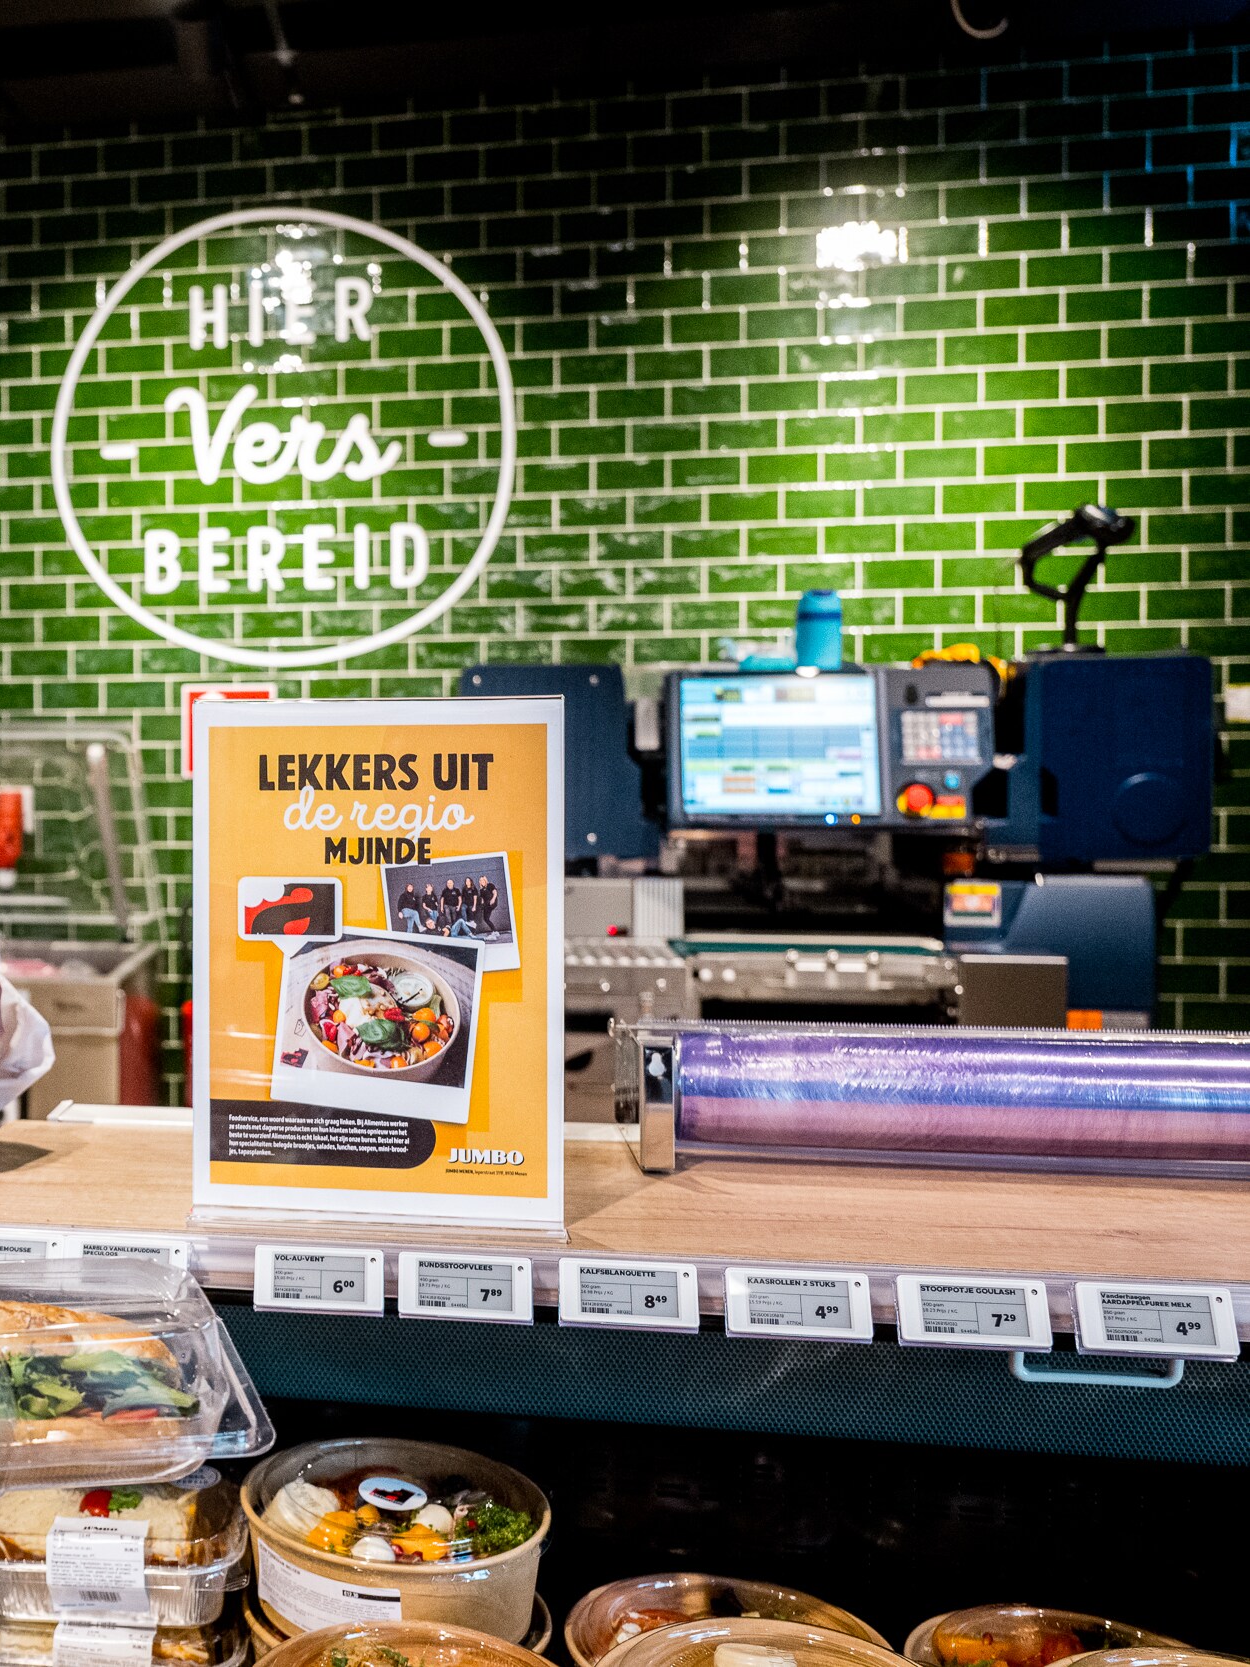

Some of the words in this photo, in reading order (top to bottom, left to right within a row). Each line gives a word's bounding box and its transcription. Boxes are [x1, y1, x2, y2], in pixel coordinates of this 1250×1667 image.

[188, 276, 374, 351] HIER
[164, 384, 403, 486] Vers
[143, 522, 429, 595] BEREID
[258, 753, 419, 791] LEKKERS
[433, 753, 494, 791] UIT
[283, 785, 343, 831] de
[349, 795, 475, 842] regio
[324, 836, 432, 865] MJINDE
[229, 1114, 259, 1123] Foodservice,
[325, 1119, 339, 1127] graag
[447, 1148, 524, 1165] JUMBO
[109, 1246, 161, 1254] VANILLEPUDDING
[274, 1254, 325, 1262] VOL-AU-VENT
[418, 1261, 492, 1271] RUNDSSTOOFVLEES
[580, 1268, 656, 1278] KALFSBLANQUETTE
[747, 1277, 800, 1286] KAASROLLEN
[810, 1280, 836, 1288] STUKS
[920, 1285, 974, 1294] STOOFPOTJE
[976, 1288, 1016, 1296] GOULASH
[1102, 1300, 1170, 1308] AARDAPPELPUREE
